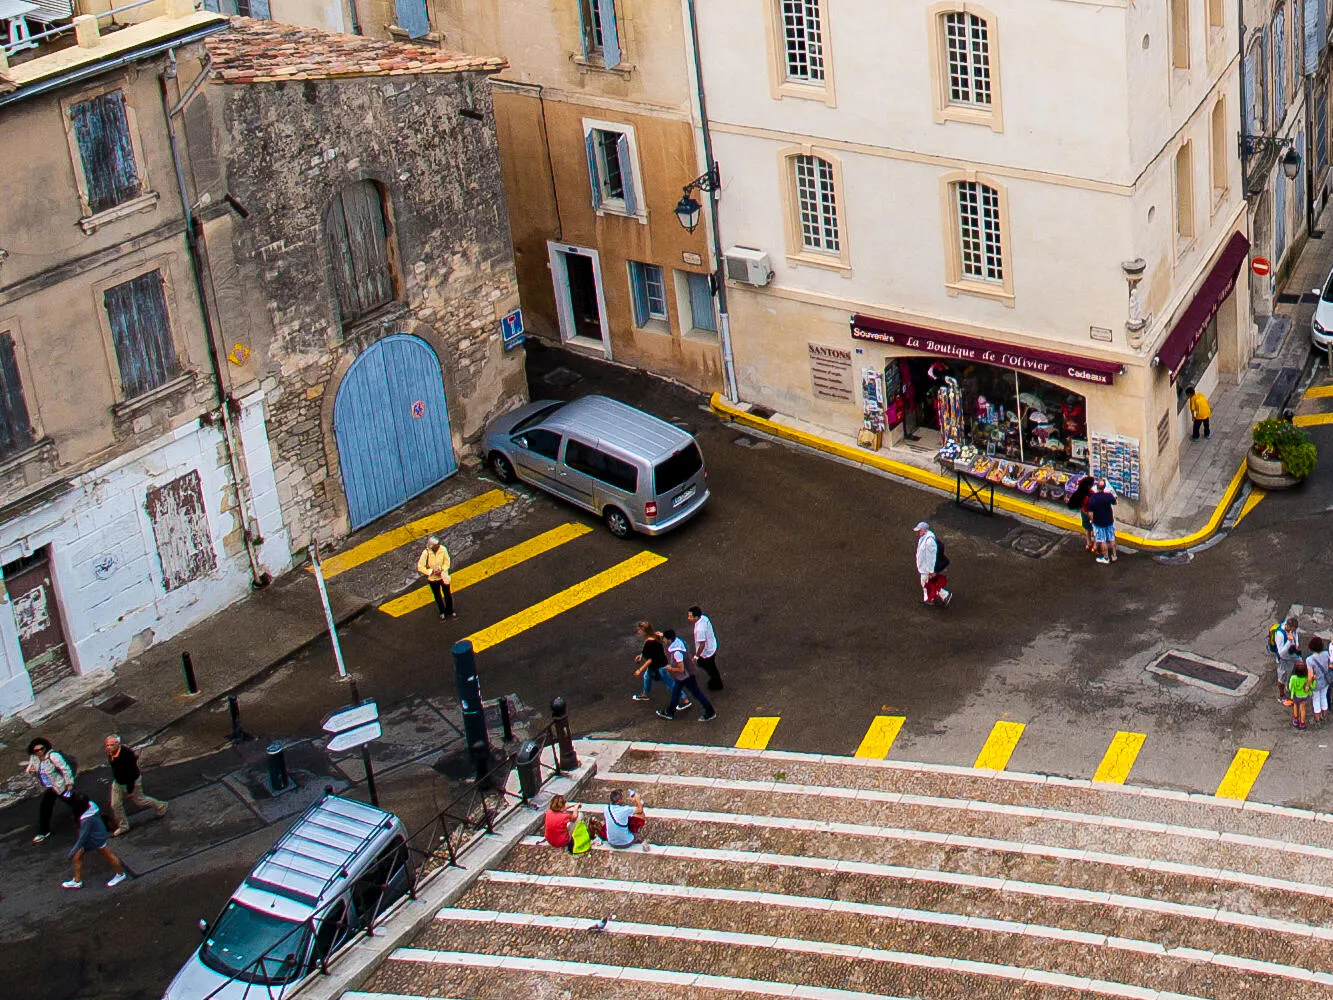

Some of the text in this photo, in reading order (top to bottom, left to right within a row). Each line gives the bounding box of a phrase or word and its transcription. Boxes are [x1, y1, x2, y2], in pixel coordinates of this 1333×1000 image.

[808, 344, 851, 360] SANTONS
[906, 336, 1050, 372] La Boutique de l'Olivier
[1067, 367, 1107, 383] Cadeaux
